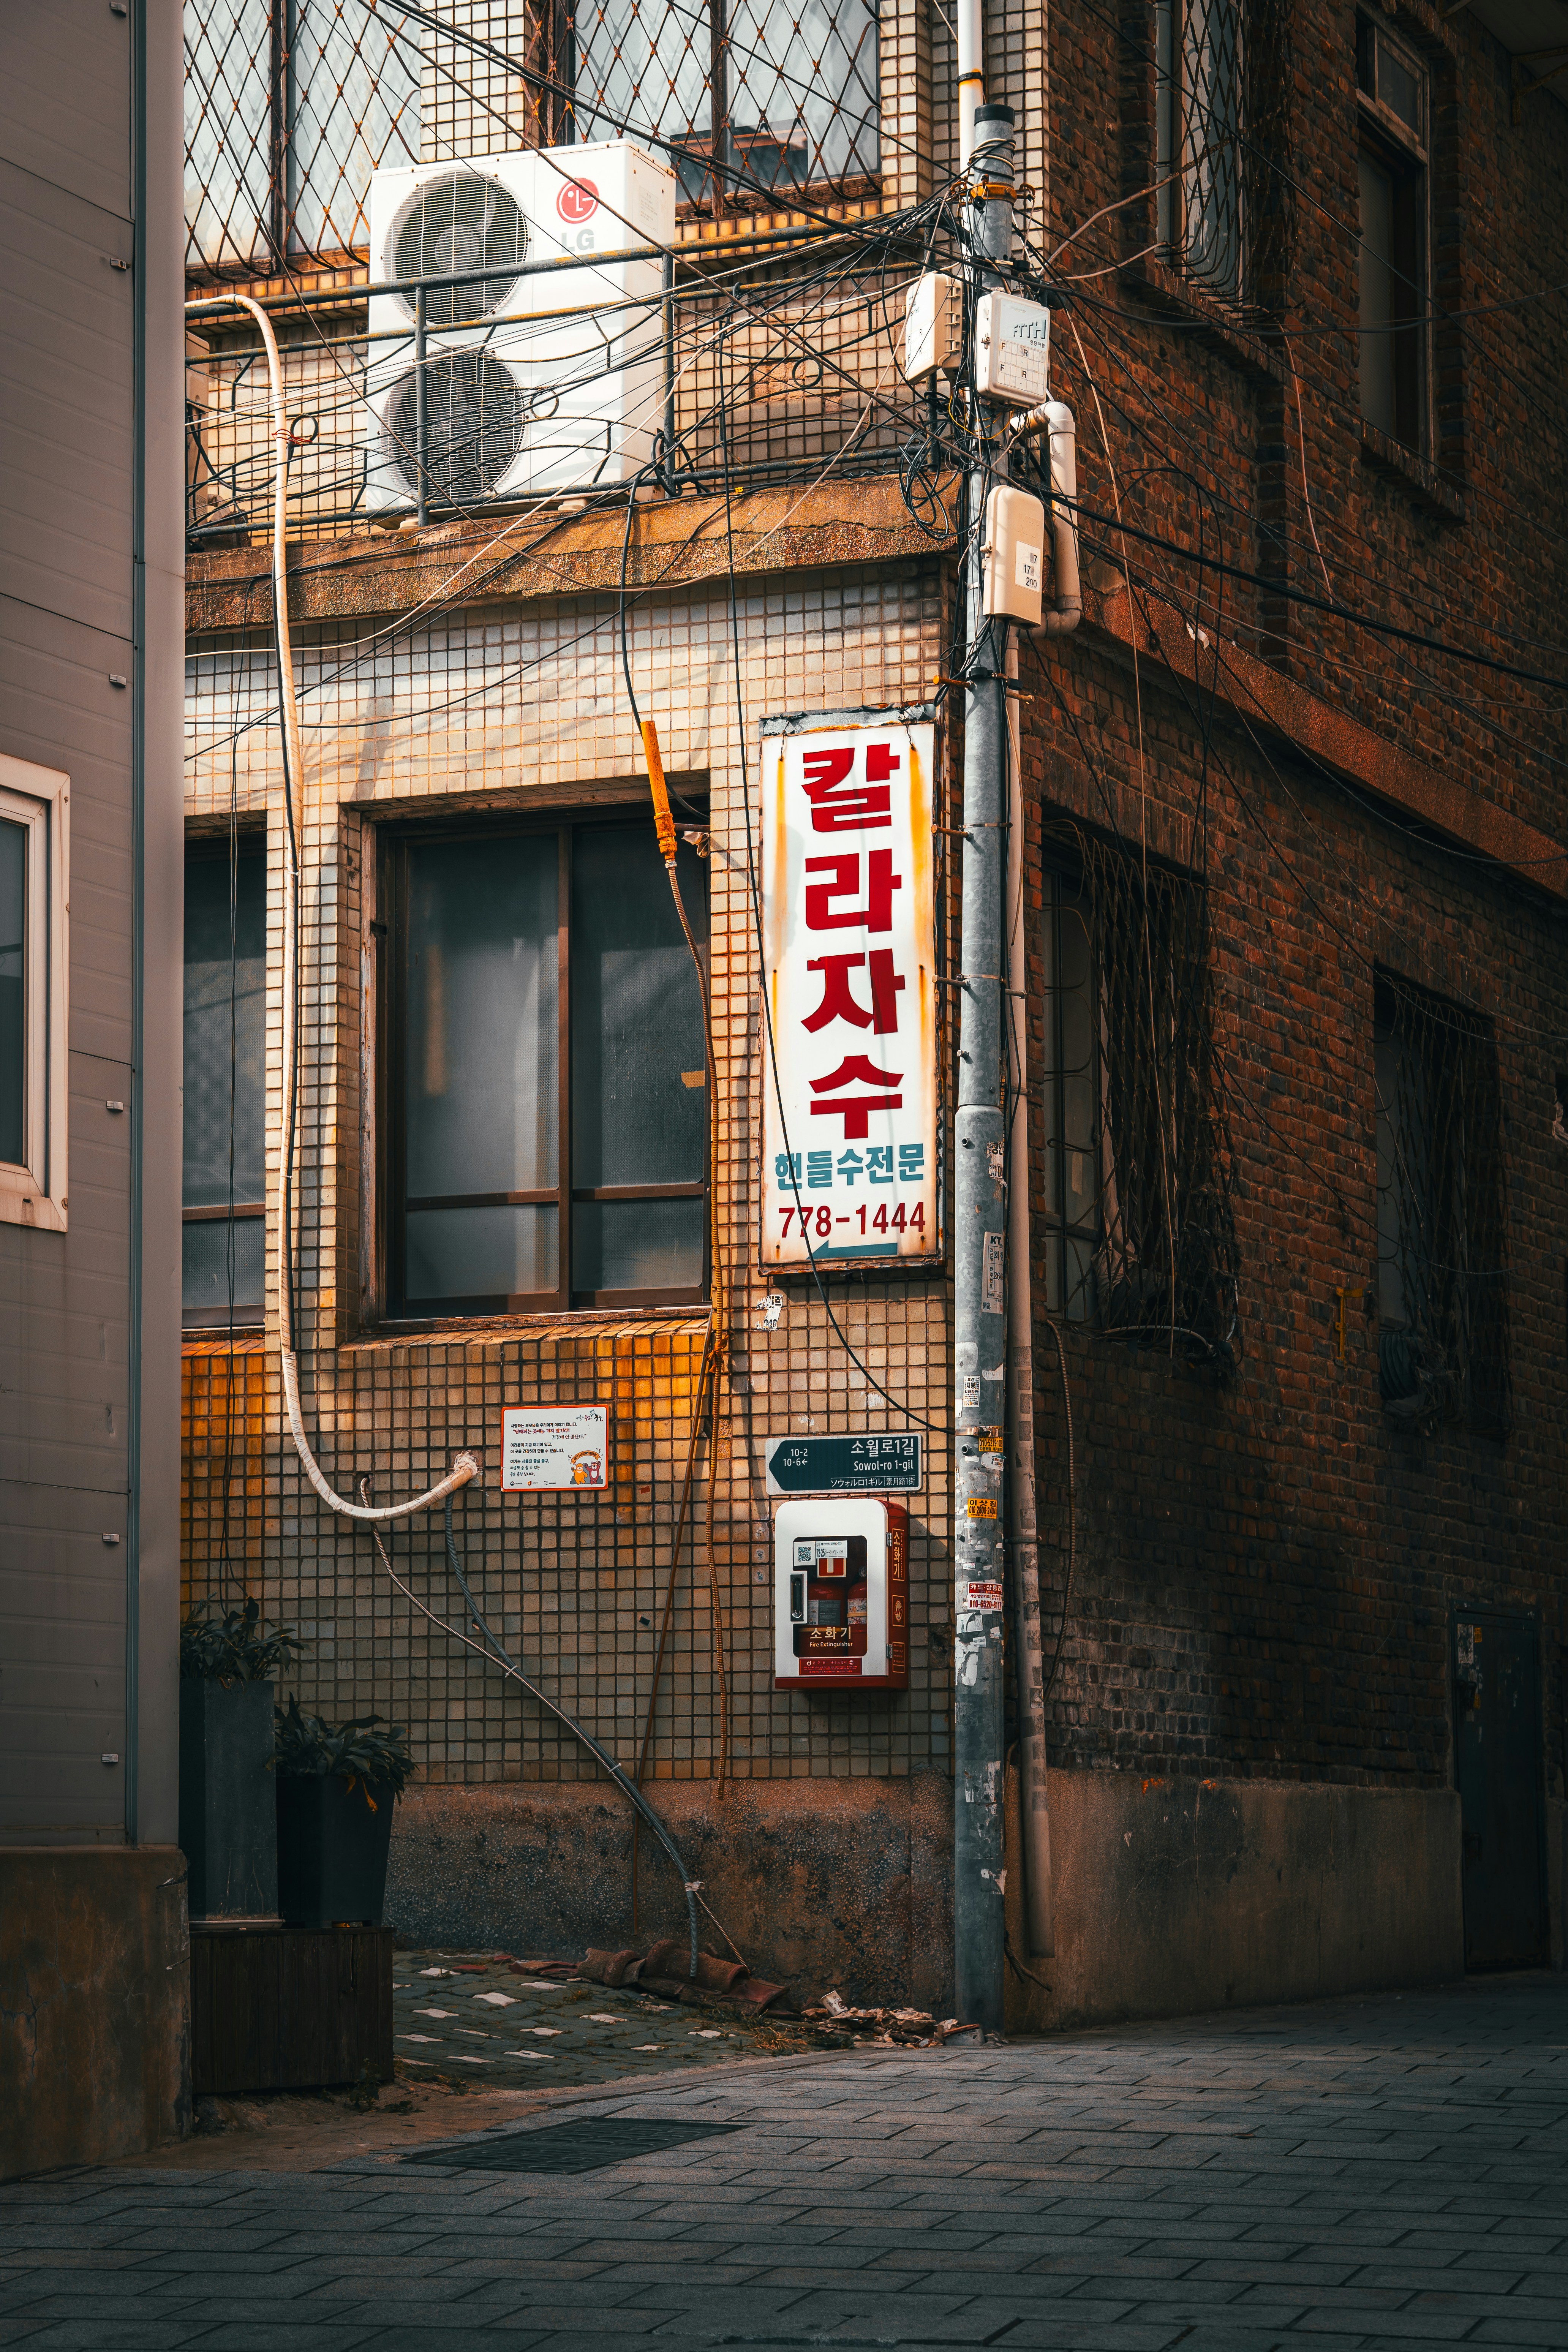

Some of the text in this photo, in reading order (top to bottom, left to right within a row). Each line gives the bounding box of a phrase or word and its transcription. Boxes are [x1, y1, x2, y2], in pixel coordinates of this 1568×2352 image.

[561, 229, 594, 253] LG
[1013, 319, 1046, 339] FTTH
[1030, 340, 1045, 348] 광단자함
[801, 743, 906, 1140] 칼라자수
[775, 1143, 925, 1190] 핸들수전문
[779, 1201, 926, 1238] 778-1444
[990, 1235, 1002, 1245] KT
[993, 1271, 1003, 1281] 264
[790, 1448, 808, 1457] 10-2
[851, 1438, 914, 1457] 소월로1길
[783, 1458, 801, 1467] 10-6
[854, 1459, 914, 1472] Sowol-ro 1-gil
[831, 1477, 883, 1487] ソウォルロ1ギル
[886, 1477, 915, 1486] 素月路1街
[969, 1600, 1002, 1609] 010-6520-8117
[810, 1626, 852, 1640] 소화기
